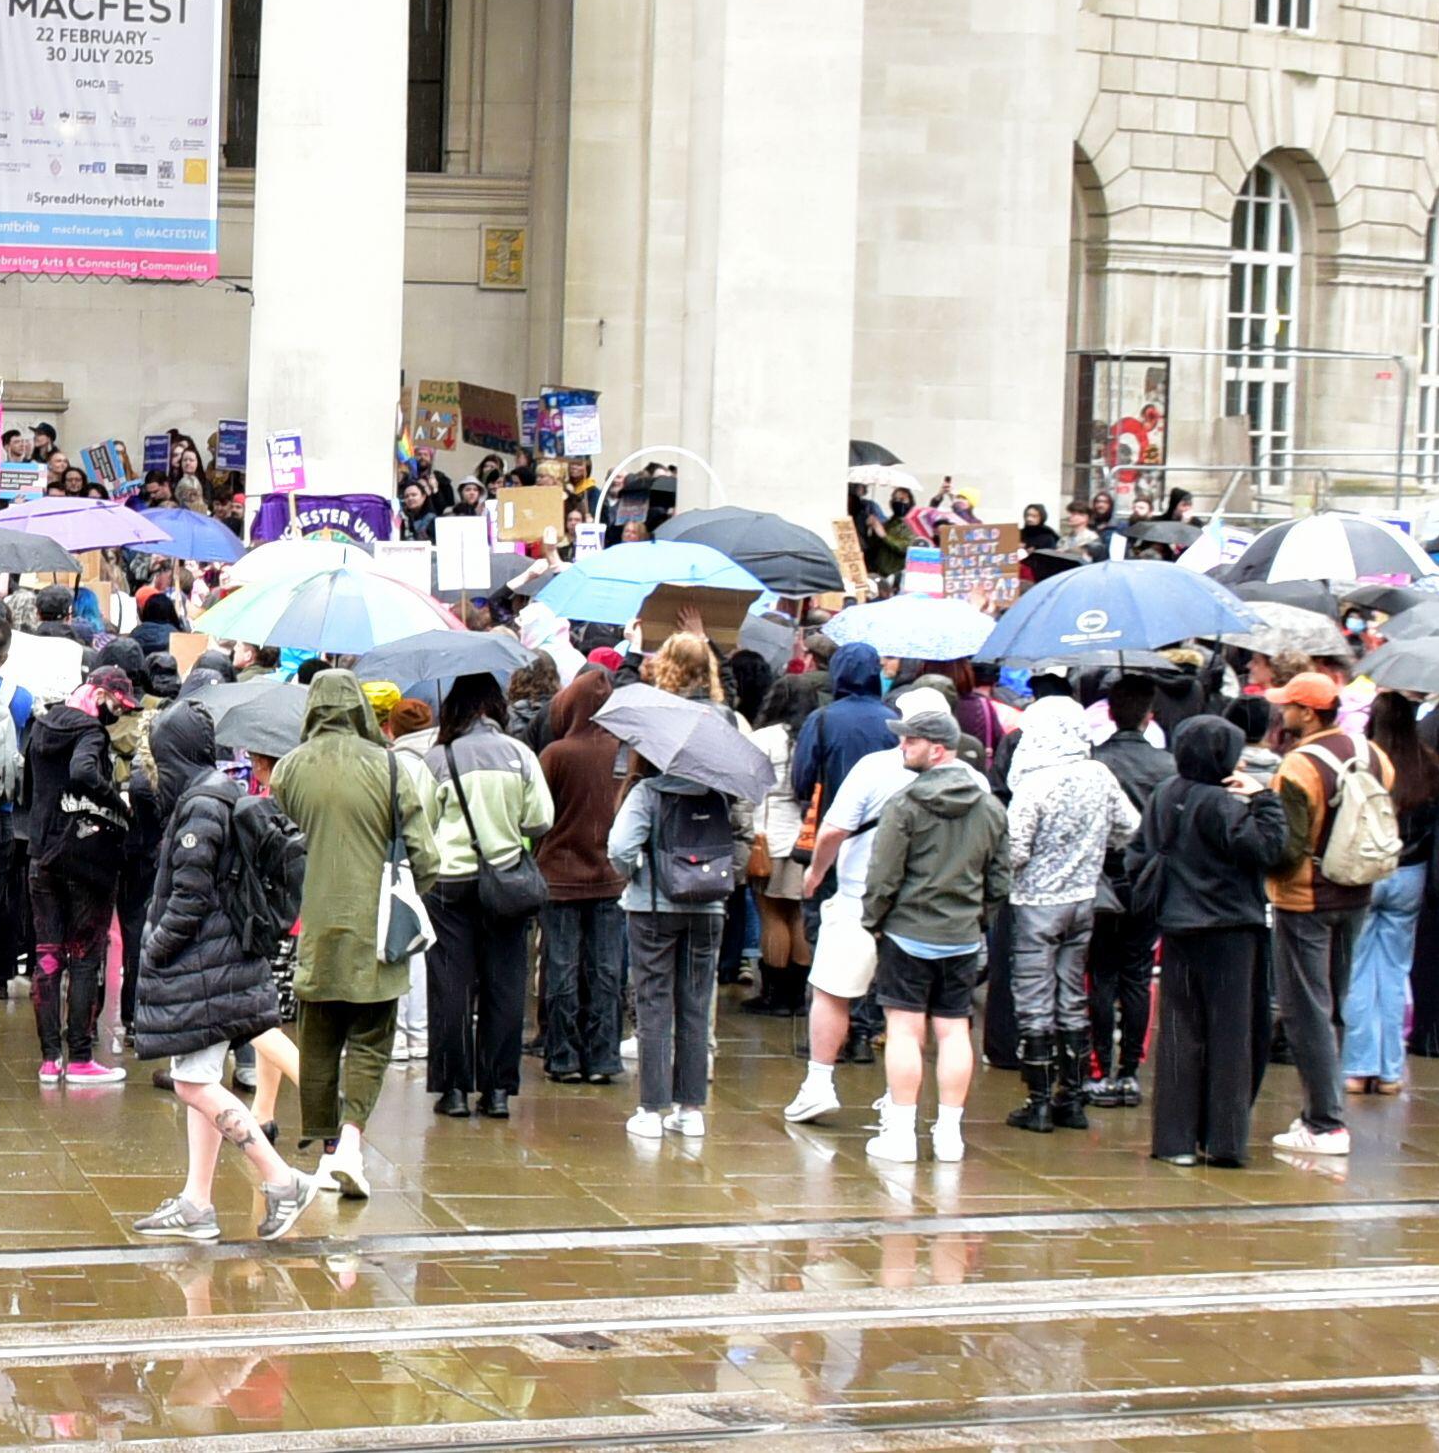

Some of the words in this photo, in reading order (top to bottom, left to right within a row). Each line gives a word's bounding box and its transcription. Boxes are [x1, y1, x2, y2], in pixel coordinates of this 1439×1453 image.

[36, 27, 54, 42] 22
[60, 28, 147, 45] FEBRUARY
[46, 46, 66, 61] 30
[71, 48, 110, 63] JULY
[114, 49, 153, 65] 2025
[26, 192, 165, 208] #SpreadHoneyNotHate
[52, 226, 124, 239] macfest.org.uk
[134, 227, 207, 240] @MACFESTUK
[42, 256, 63, 267] Arts
[66, 257, 74, 267] &
[77, 258, 138, 272] Connecting
[140, 259, 208, 273] Communities
[429, 382, 454, 392] CIS
[948, 528, 958, 541] A
[948, 542, 999, 555] WITHOUT
